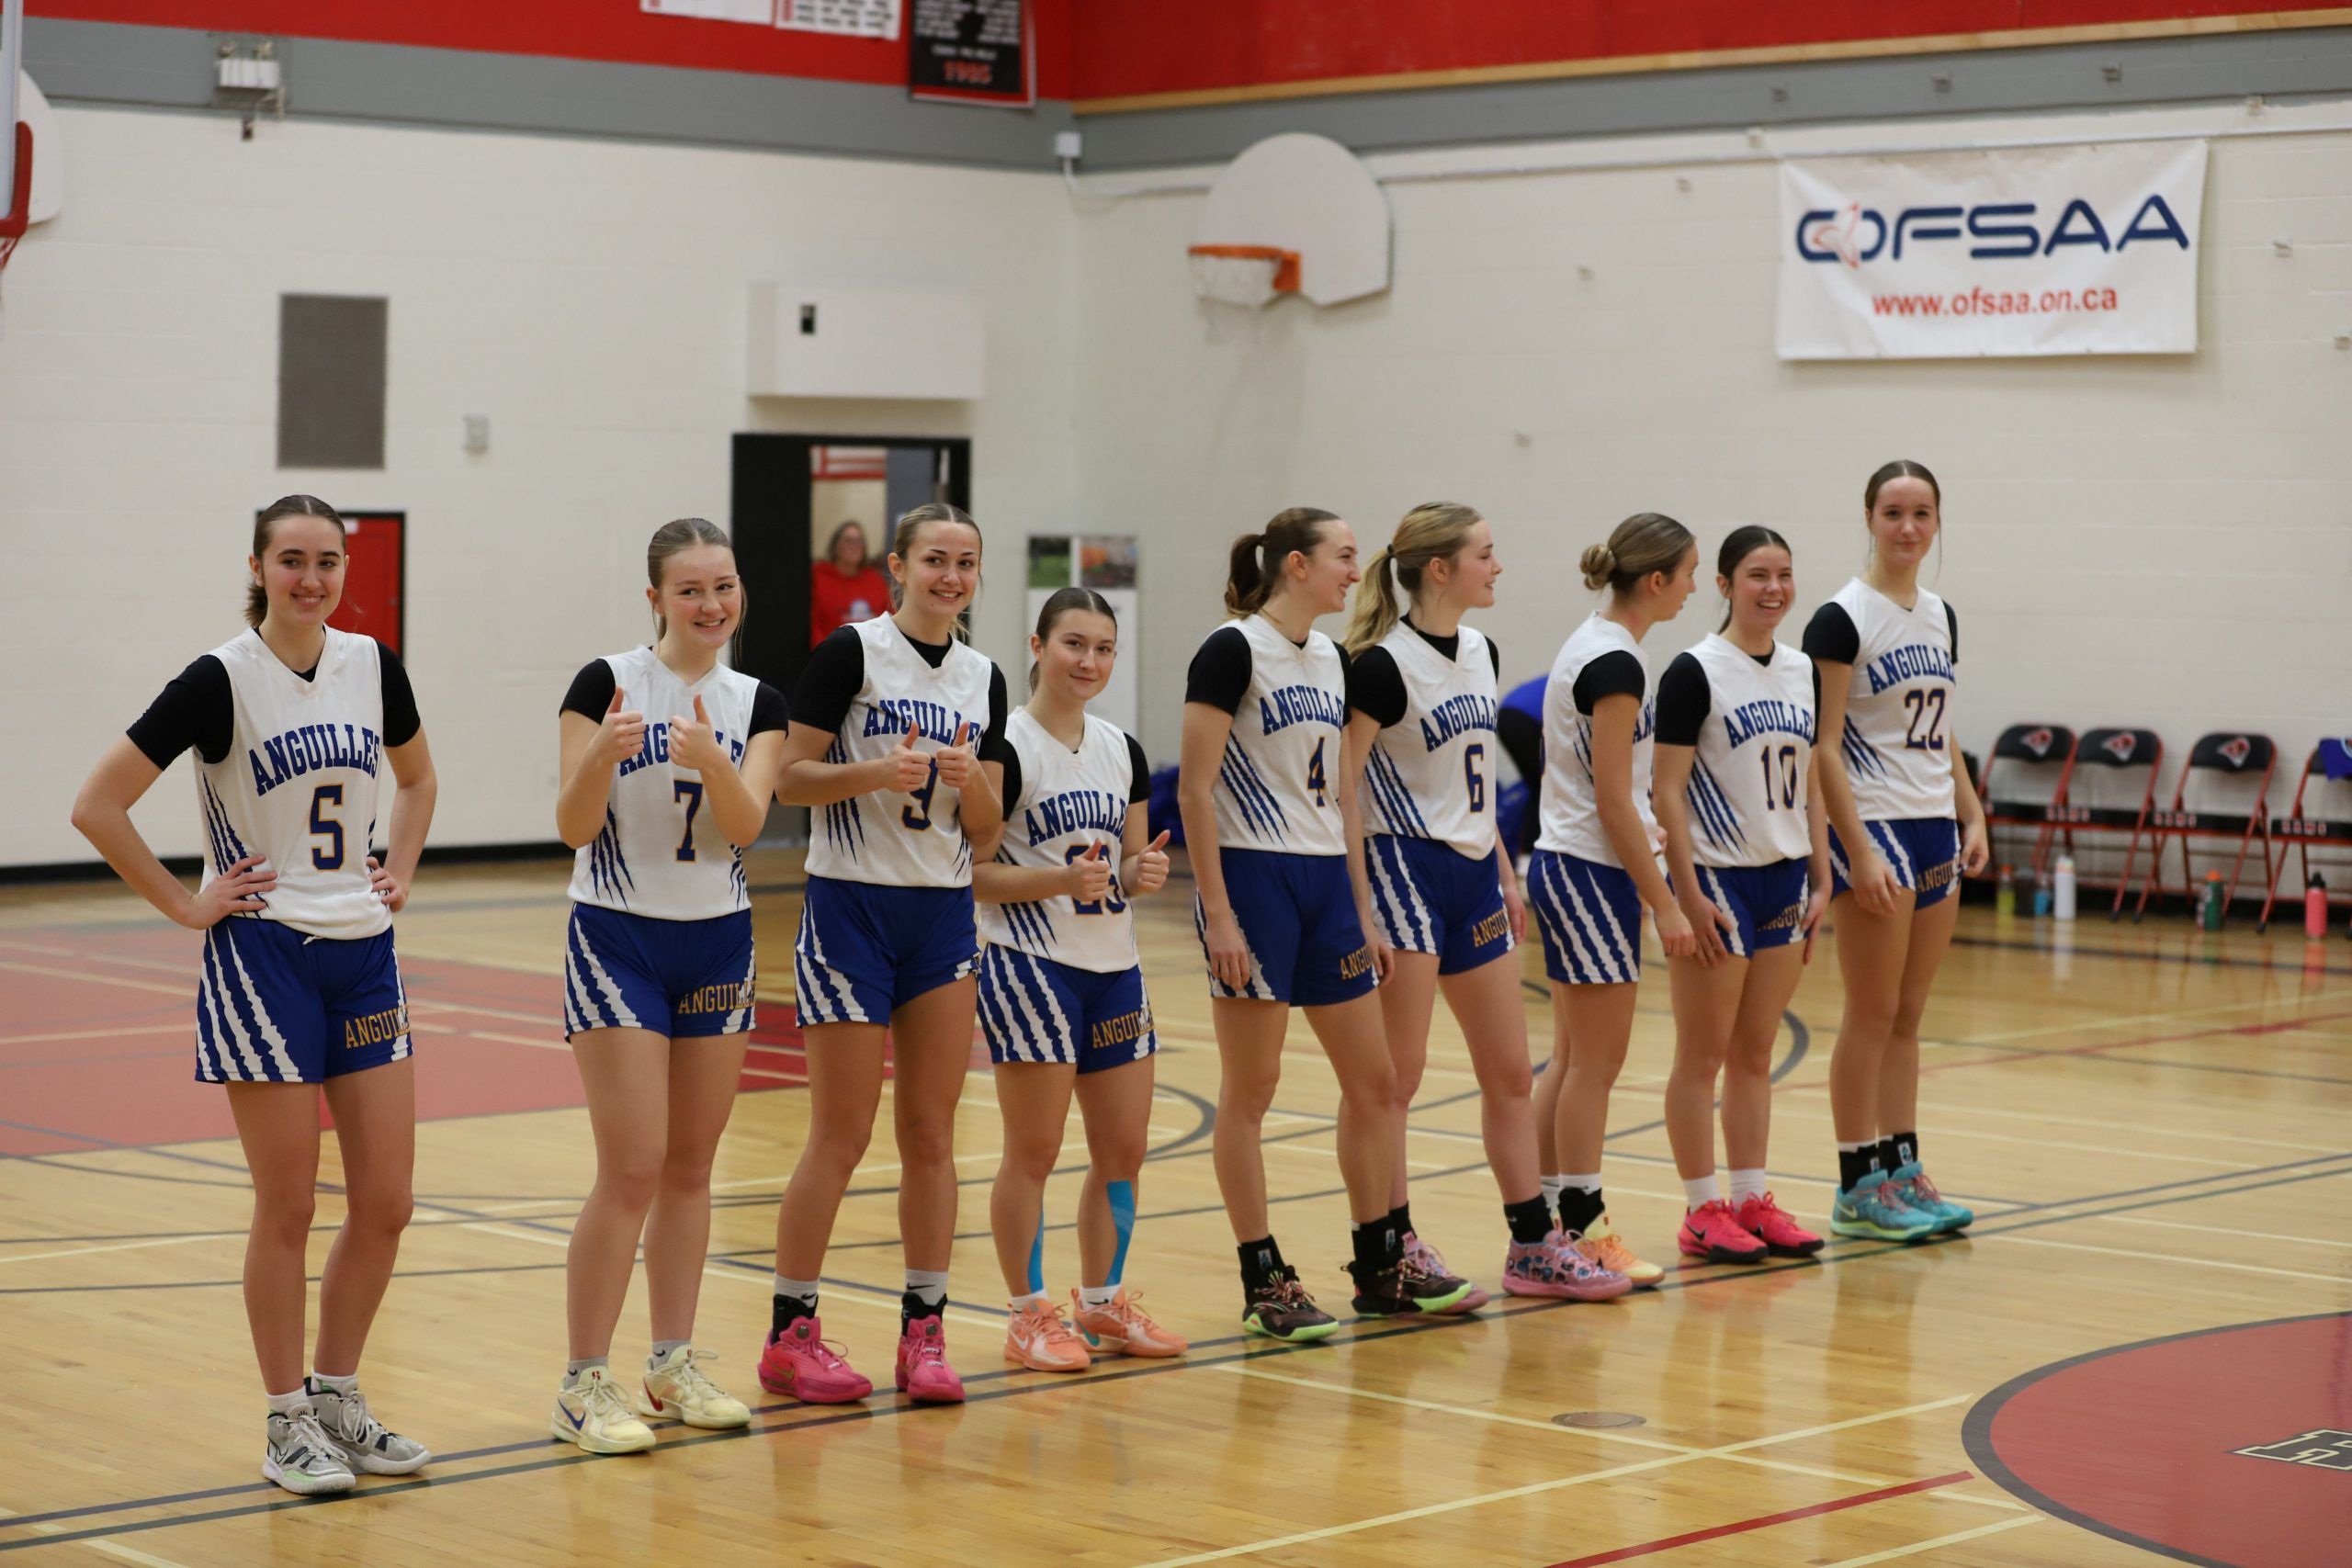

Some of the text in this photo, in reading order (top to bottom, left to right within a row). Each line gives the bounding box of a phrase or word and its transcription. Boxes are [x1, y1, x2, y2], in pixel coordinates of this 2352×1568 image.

[1796, 194, 2189, 265] OFSAA
[1872, 287, 2119, 317] www.ofsaa.on.ca
[1905, 688, 1946, 750] 22
[248, 724, 379, 796] ANGUILLES
[1307, 737, 1326, 807] 4
[1464, 743, 1484, 813] 6
[1761, 745, 1797, 809] 10
[310, 783, 344, 872] 5
[673, 779, 703, 863] 7
